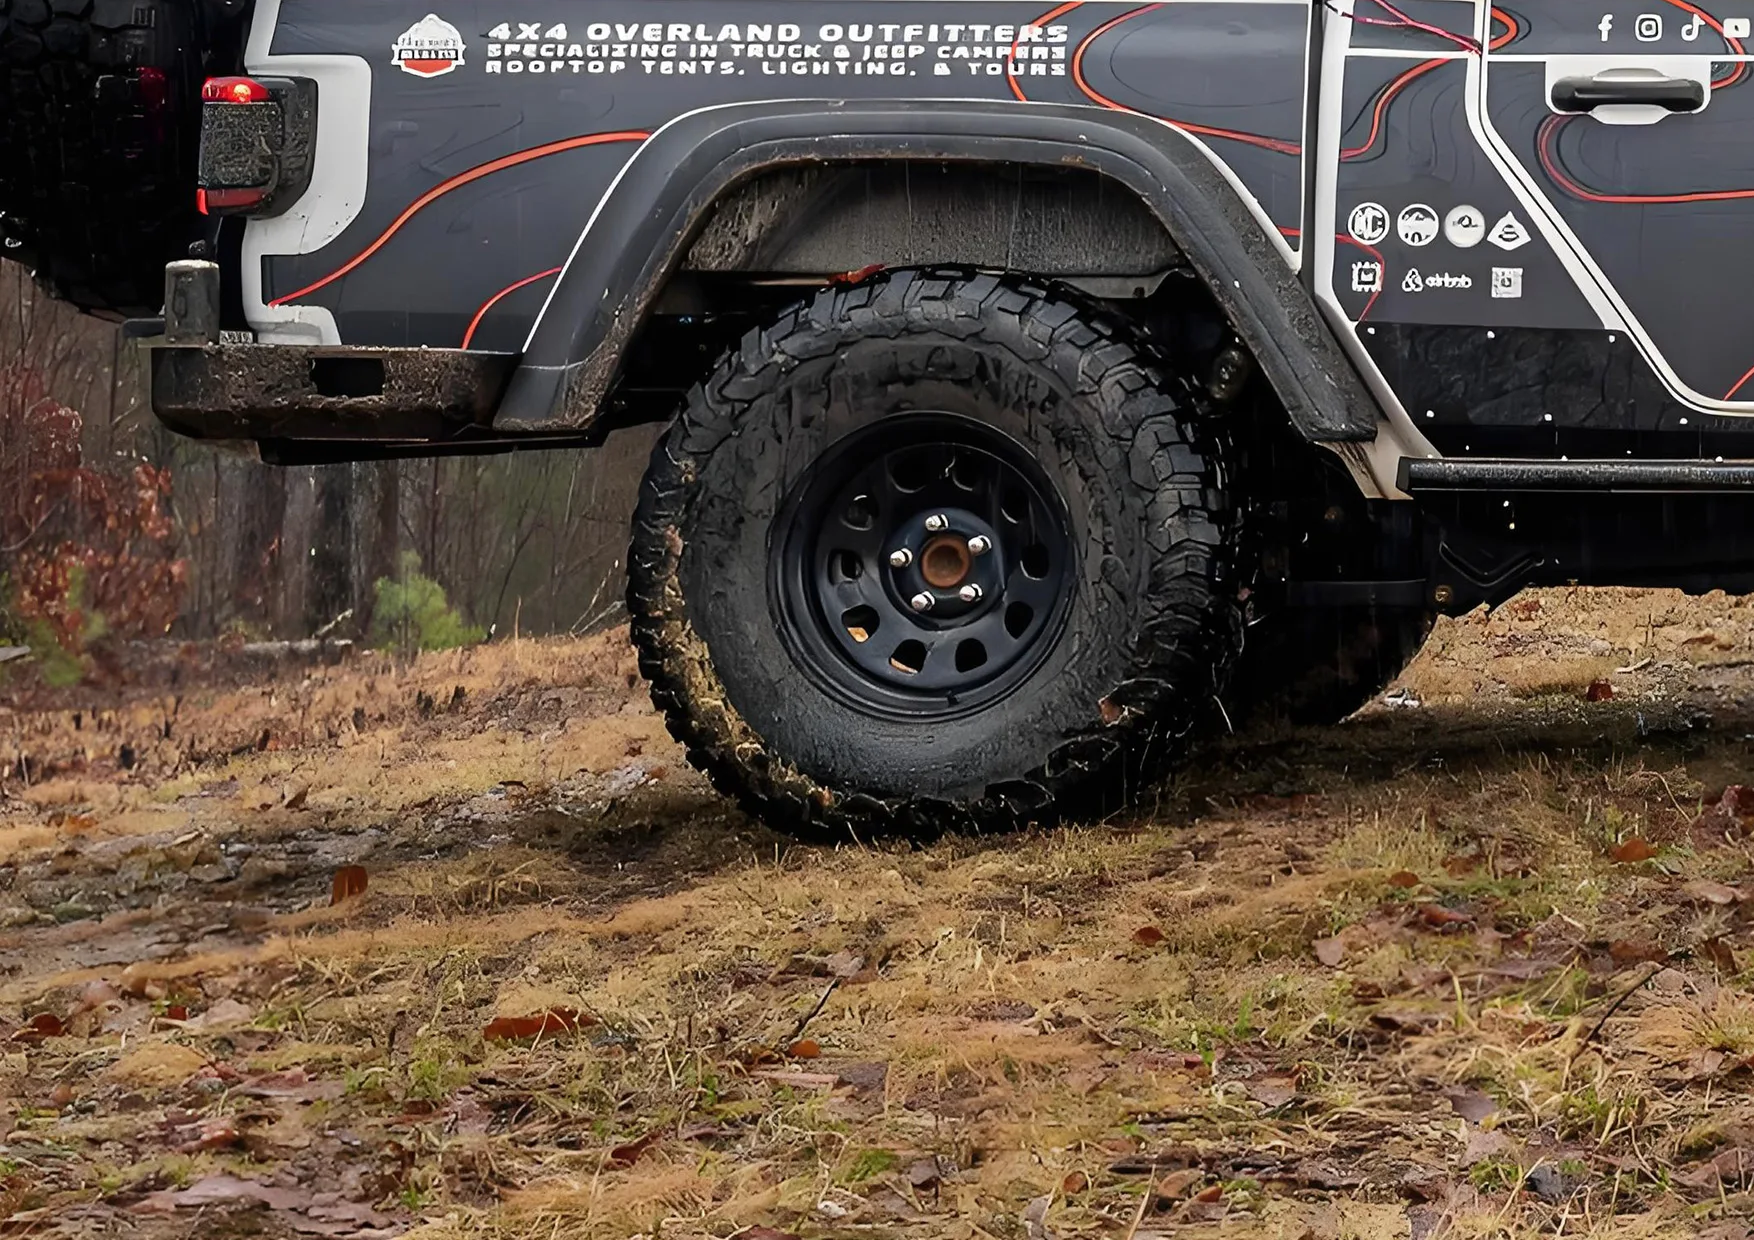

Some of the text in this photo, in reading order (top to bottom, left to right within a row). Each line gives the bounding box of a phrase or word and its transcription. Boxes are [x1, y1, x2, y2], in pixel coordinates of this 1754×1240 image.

[586, 23, 801, 42] OVERLAND
[818, 24, 1068, 43] OUTFITTERS
[689, 43, 718, 58] IN
[730, 43, 822, 59] TRUCK
[862, 45, 926, 61] JEEP
[967, 63, 1066, 76] TOURS
